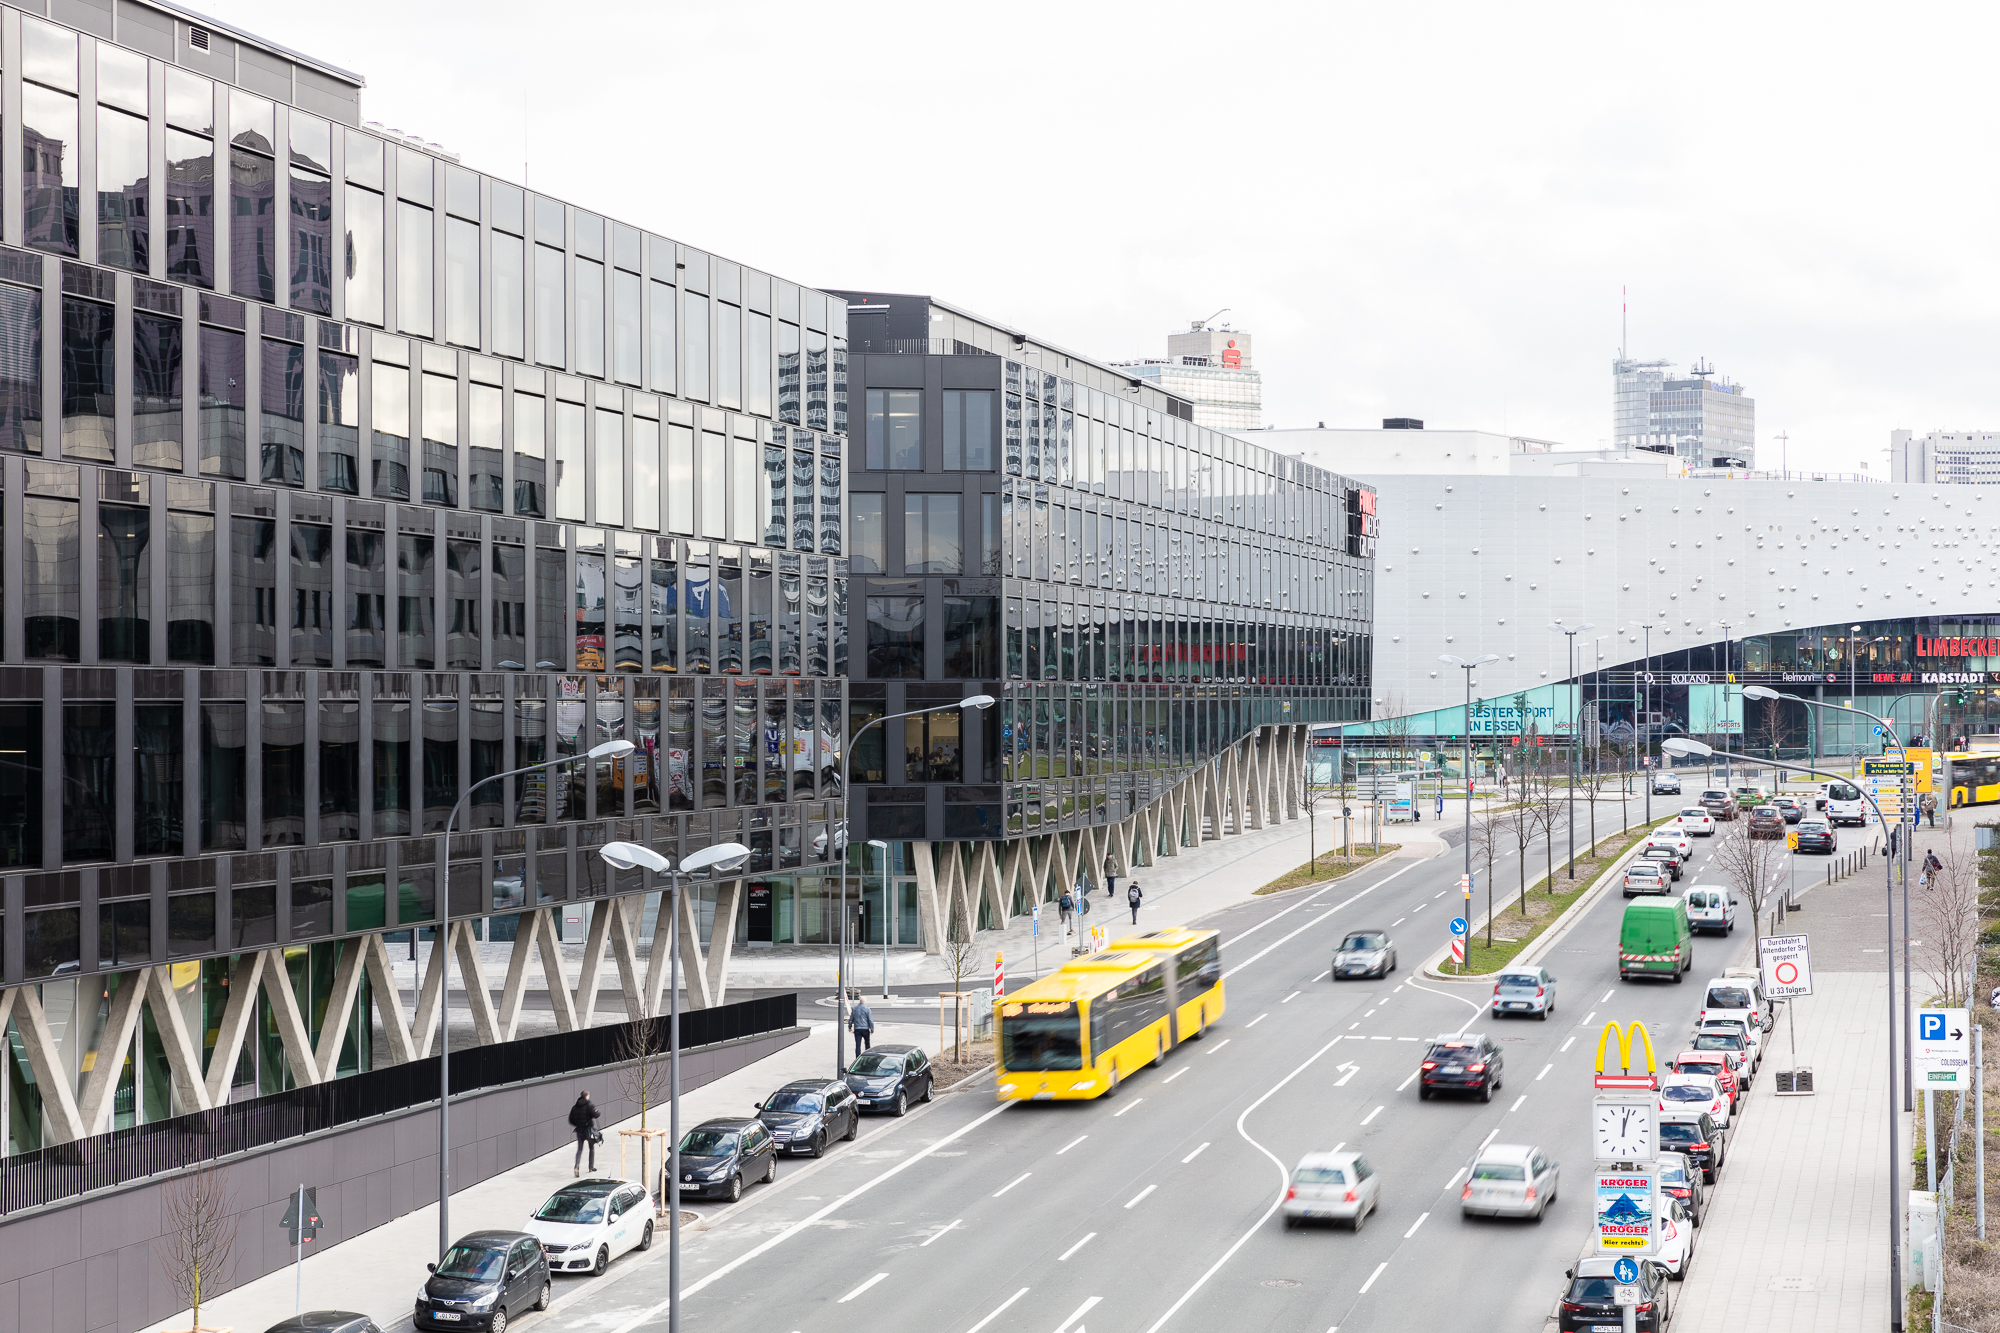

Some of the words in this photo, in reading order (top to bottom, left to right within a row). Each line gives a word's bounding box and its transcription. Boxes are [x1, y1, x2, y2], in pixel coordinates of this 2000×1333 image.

[1917, 634, 2000, 656] LIMBECKE
[1671, 674, 1710, 684] ROLAND
[1873, 674, 1896, 682] REWE
[1921, 672, 1984, 683] KARSTADT
[1470, 708, 1513, 718] BESTER
[1484, 720, 1522, 732] ESSEN
[1763, 946, 1796, 954] Altendorfer
[1773, 953, 1798, 962] gesperrt
[1786, 986, 1806, 994] folgen
[1925, 1016, 1941, 1038] P
[1602, 1225, 1649, 1233] KRÖGER
